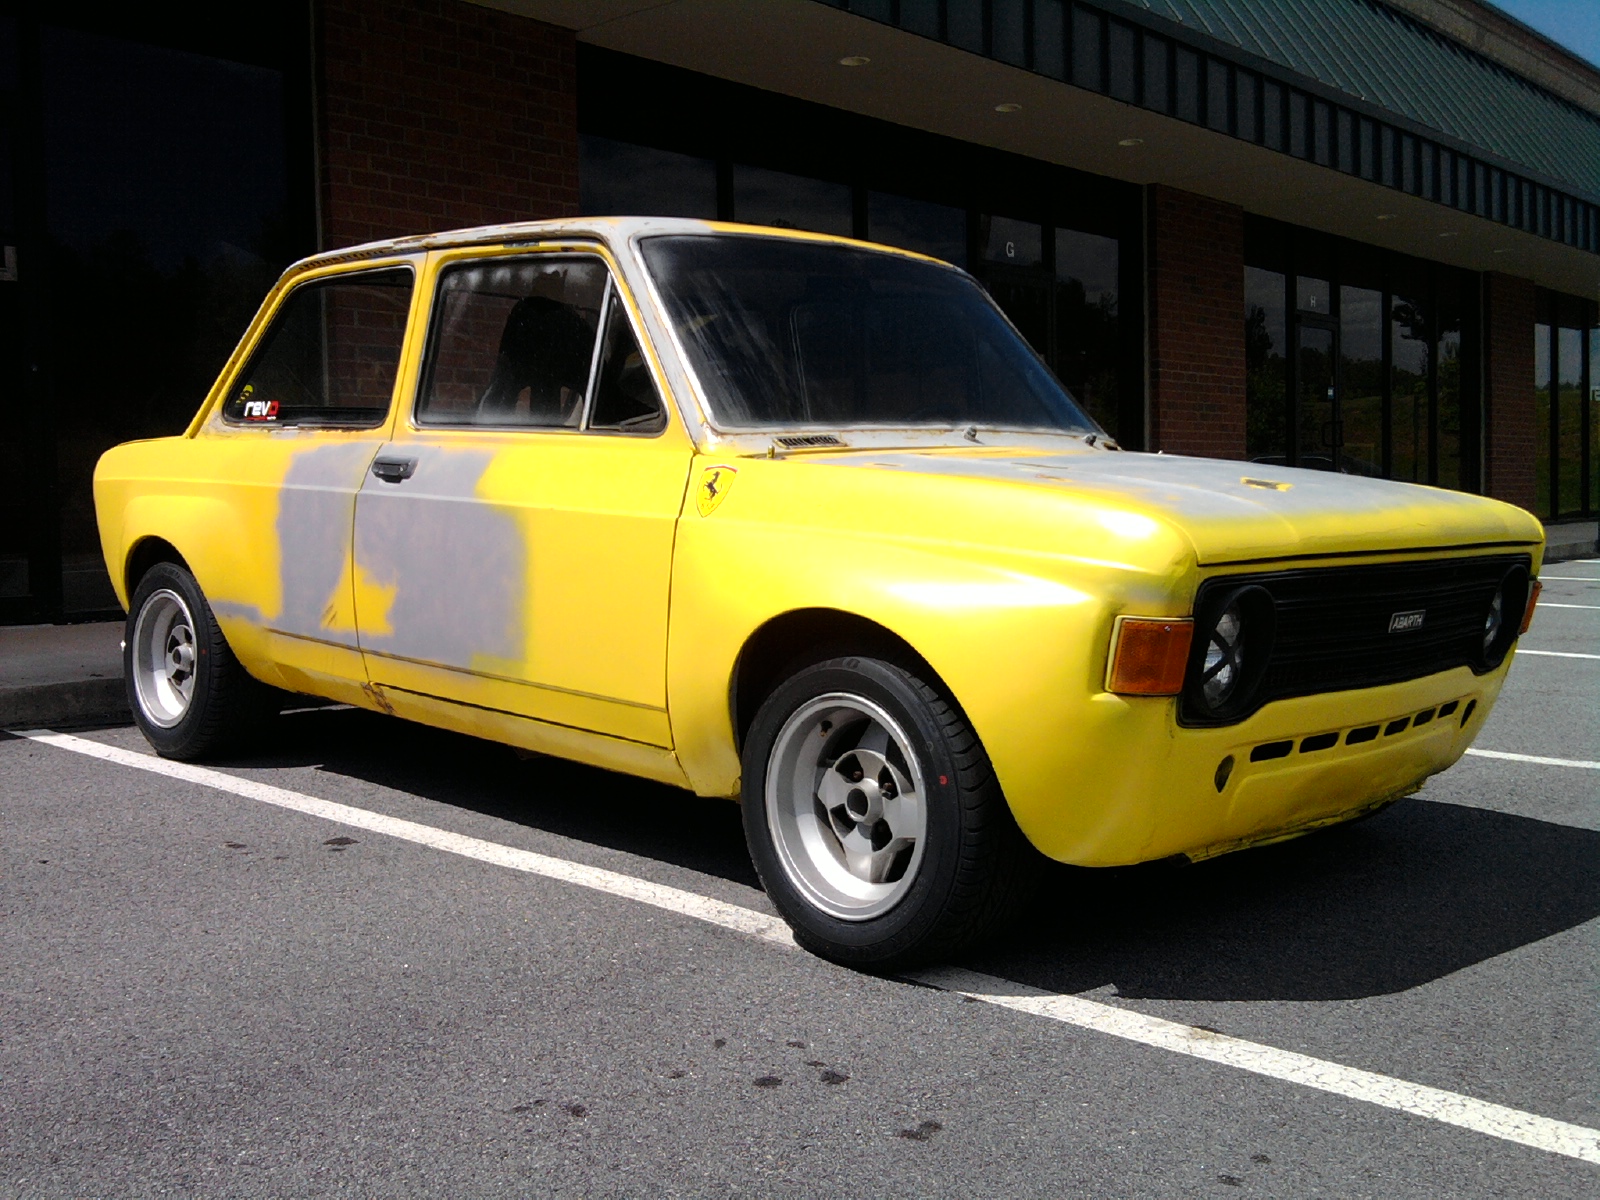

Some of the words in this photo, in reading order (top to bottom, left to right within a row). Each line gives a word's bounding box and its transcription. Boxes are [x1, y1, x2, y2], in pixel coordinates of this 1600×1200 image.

[1006, 241, 1015, 258] G
[1310, 295, 1316, 308] H
[1392, 614, 1424, 630] ABARTH
